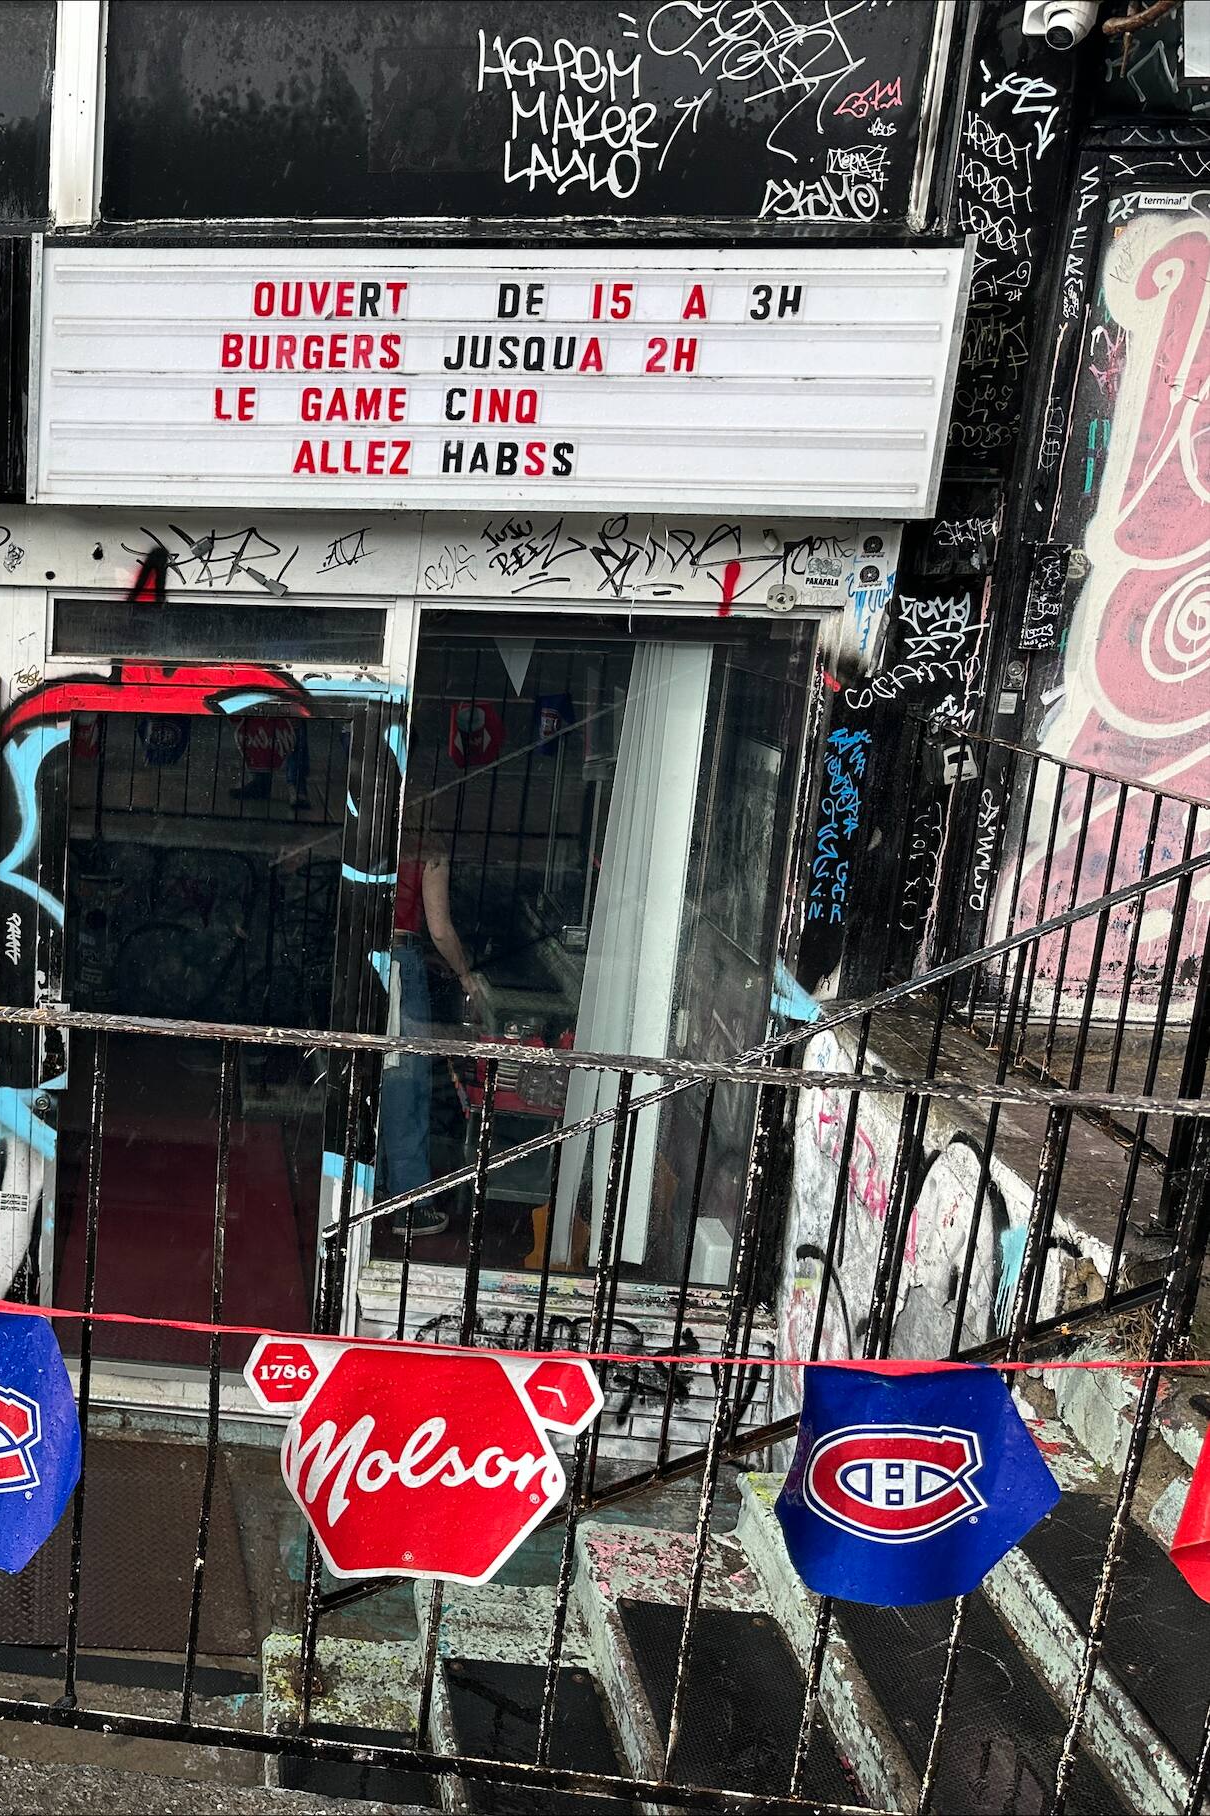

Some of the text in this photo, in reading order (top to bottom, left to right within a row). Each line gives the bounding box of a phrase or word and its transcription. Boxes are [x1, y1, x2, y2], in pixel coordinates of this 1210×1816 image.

[253, 281, 802, 320] OUVERT DE 15 A 3H
[221, 333, 698, 373] BURGERS JUSQUA 2H
[214, 387, 538, 423] LE GAME CINQ
[293, 440, 574, 476] ALLEZ HABSS
[805, 577, 839, 587] PAKAPALA
[258, 1364, 312, 1381] 1786
[285, 1414, 562, 1527] Molson
